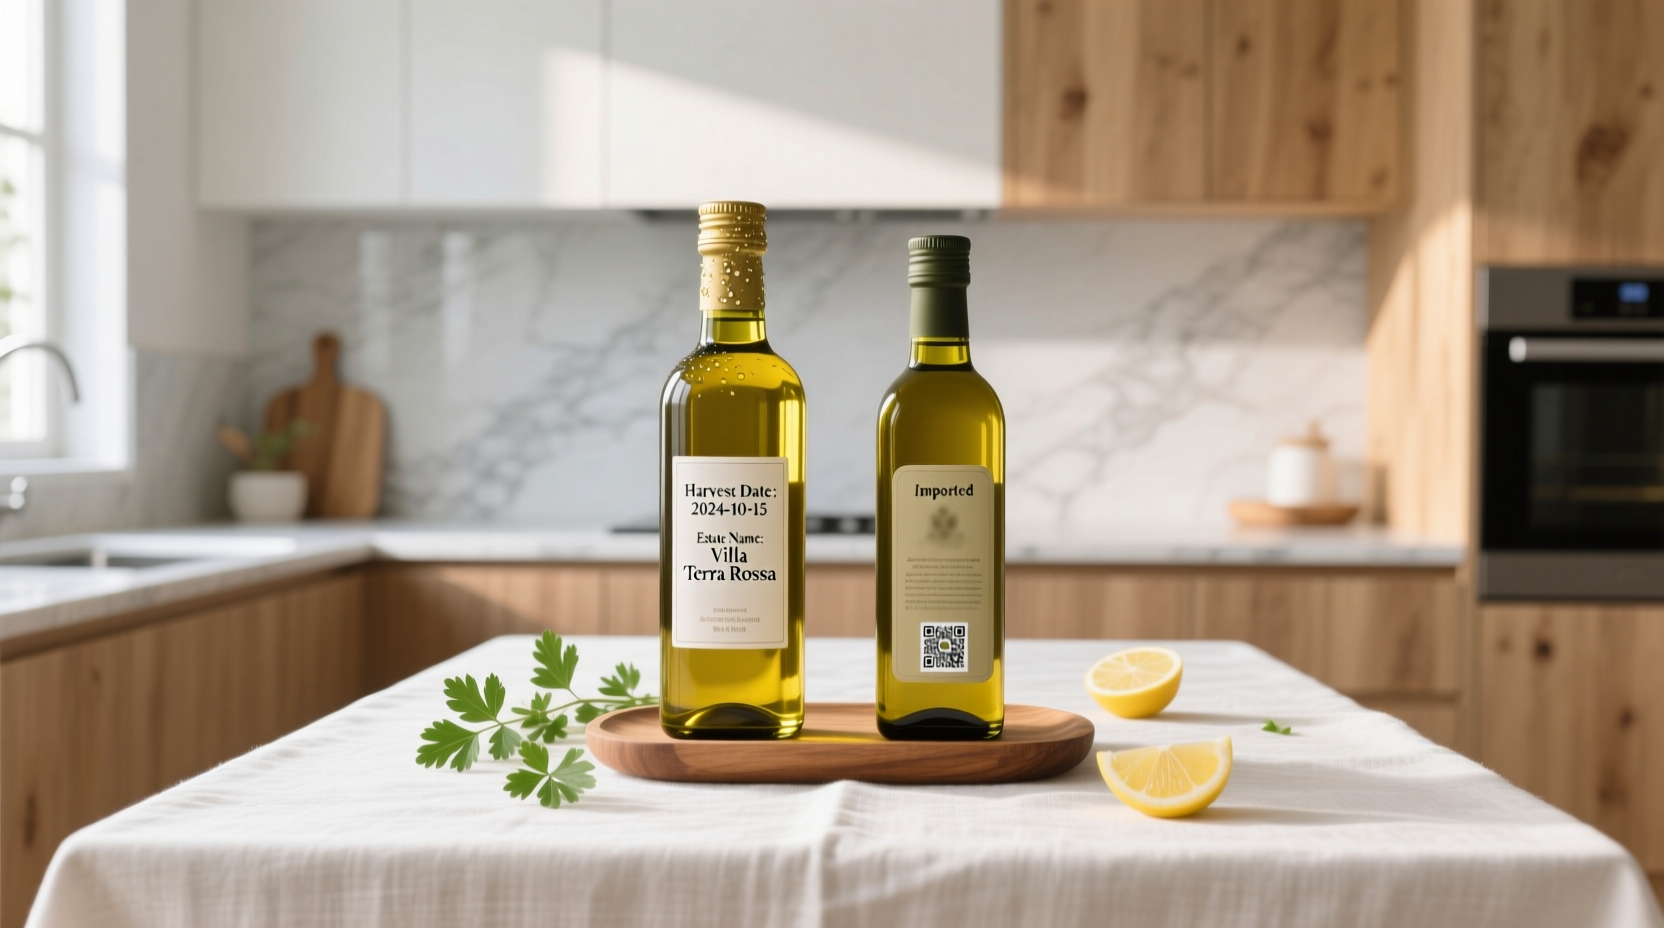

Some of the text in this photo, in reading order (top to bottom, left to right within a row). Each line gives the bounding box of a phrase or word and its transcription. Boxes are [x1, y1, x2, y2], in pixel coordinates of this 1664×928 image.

[684, 483, 777, 498] Harvest Date:
[914, 483, 974, 500] Imported
[691, 501, 768, 516] 2024-10-15
[711, 546, 748, 563] Villa
[683, 564, 777, 581] Terra Rossa
